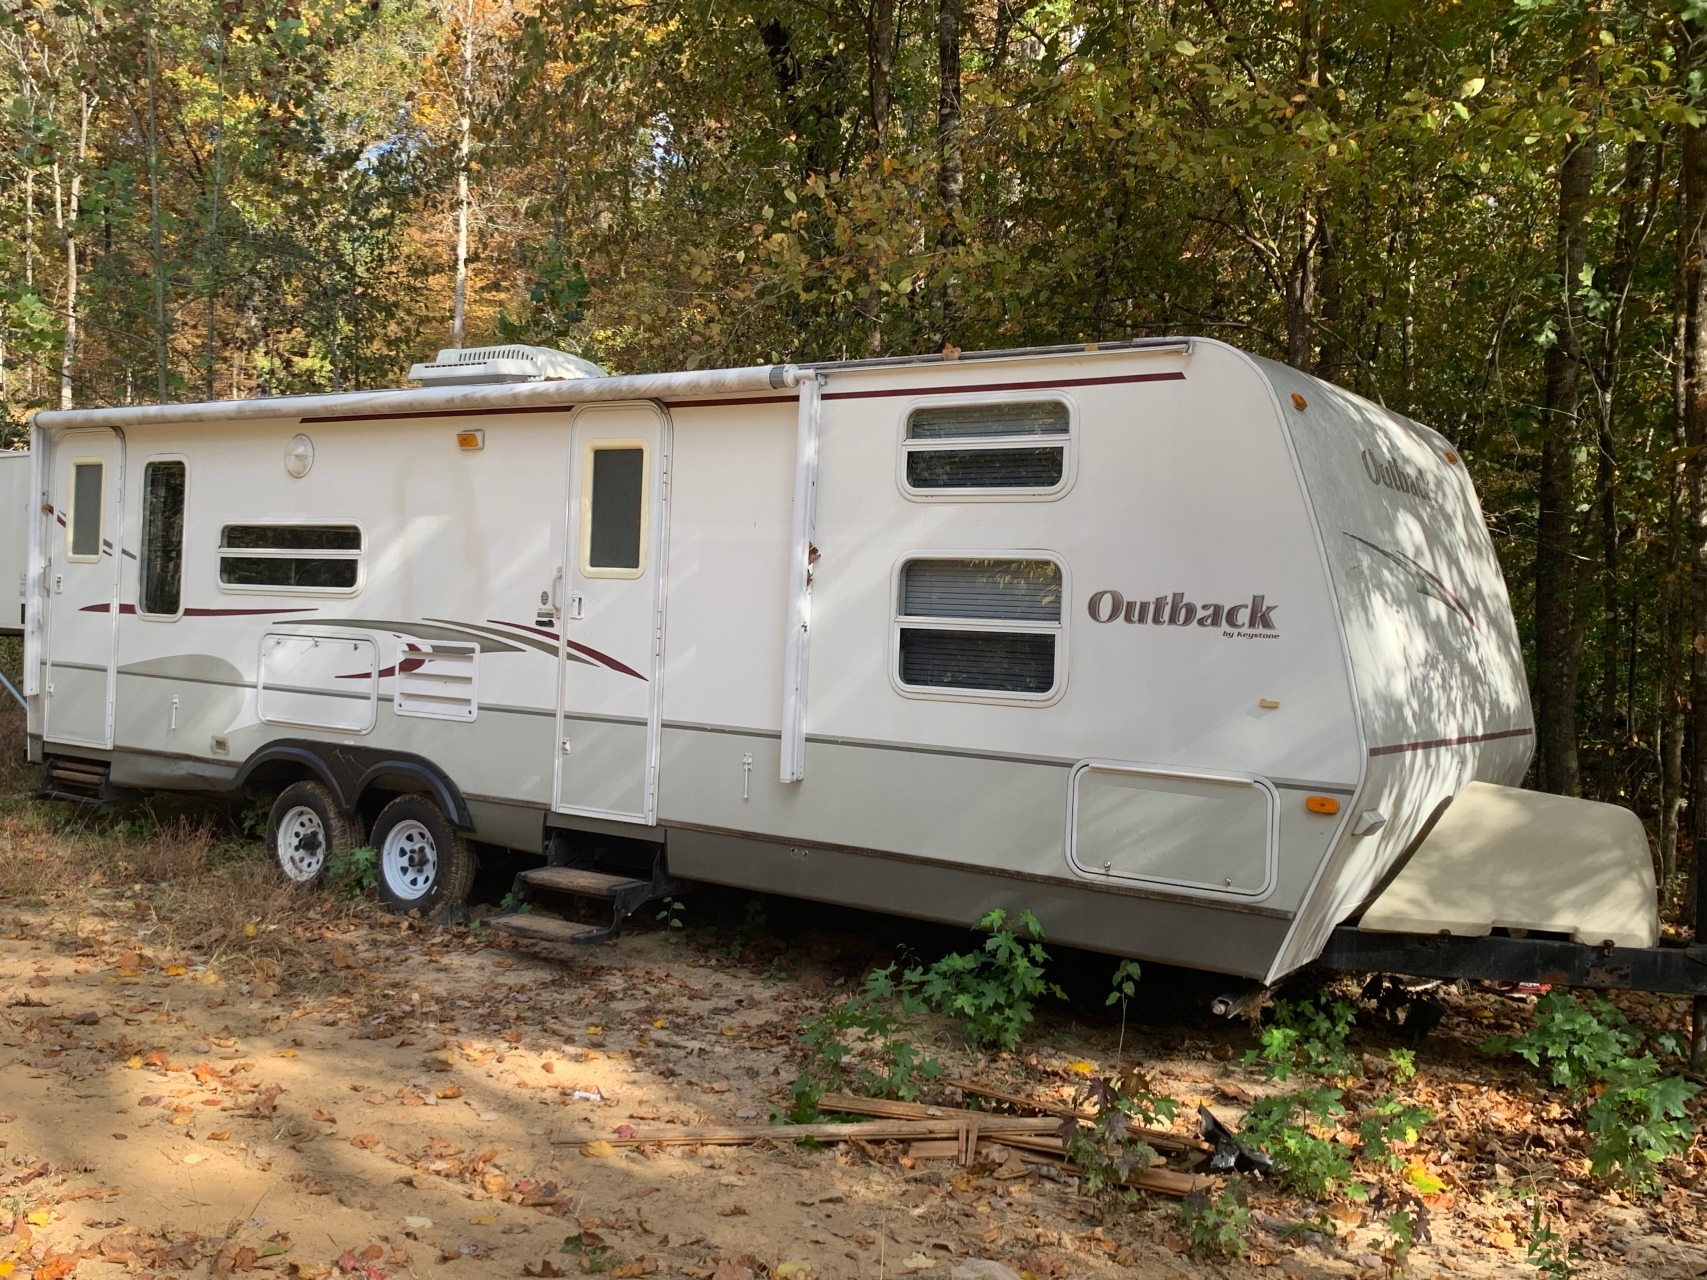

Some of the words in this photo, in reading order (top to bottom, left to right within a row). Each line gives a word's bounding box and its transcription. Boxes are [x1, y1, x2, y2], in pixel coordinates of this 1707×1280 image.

[1087, 589, 1279, 630] Outback
[1222, 630, 1235, 639] by
[1236, 631, 1280, 640] Keystone
